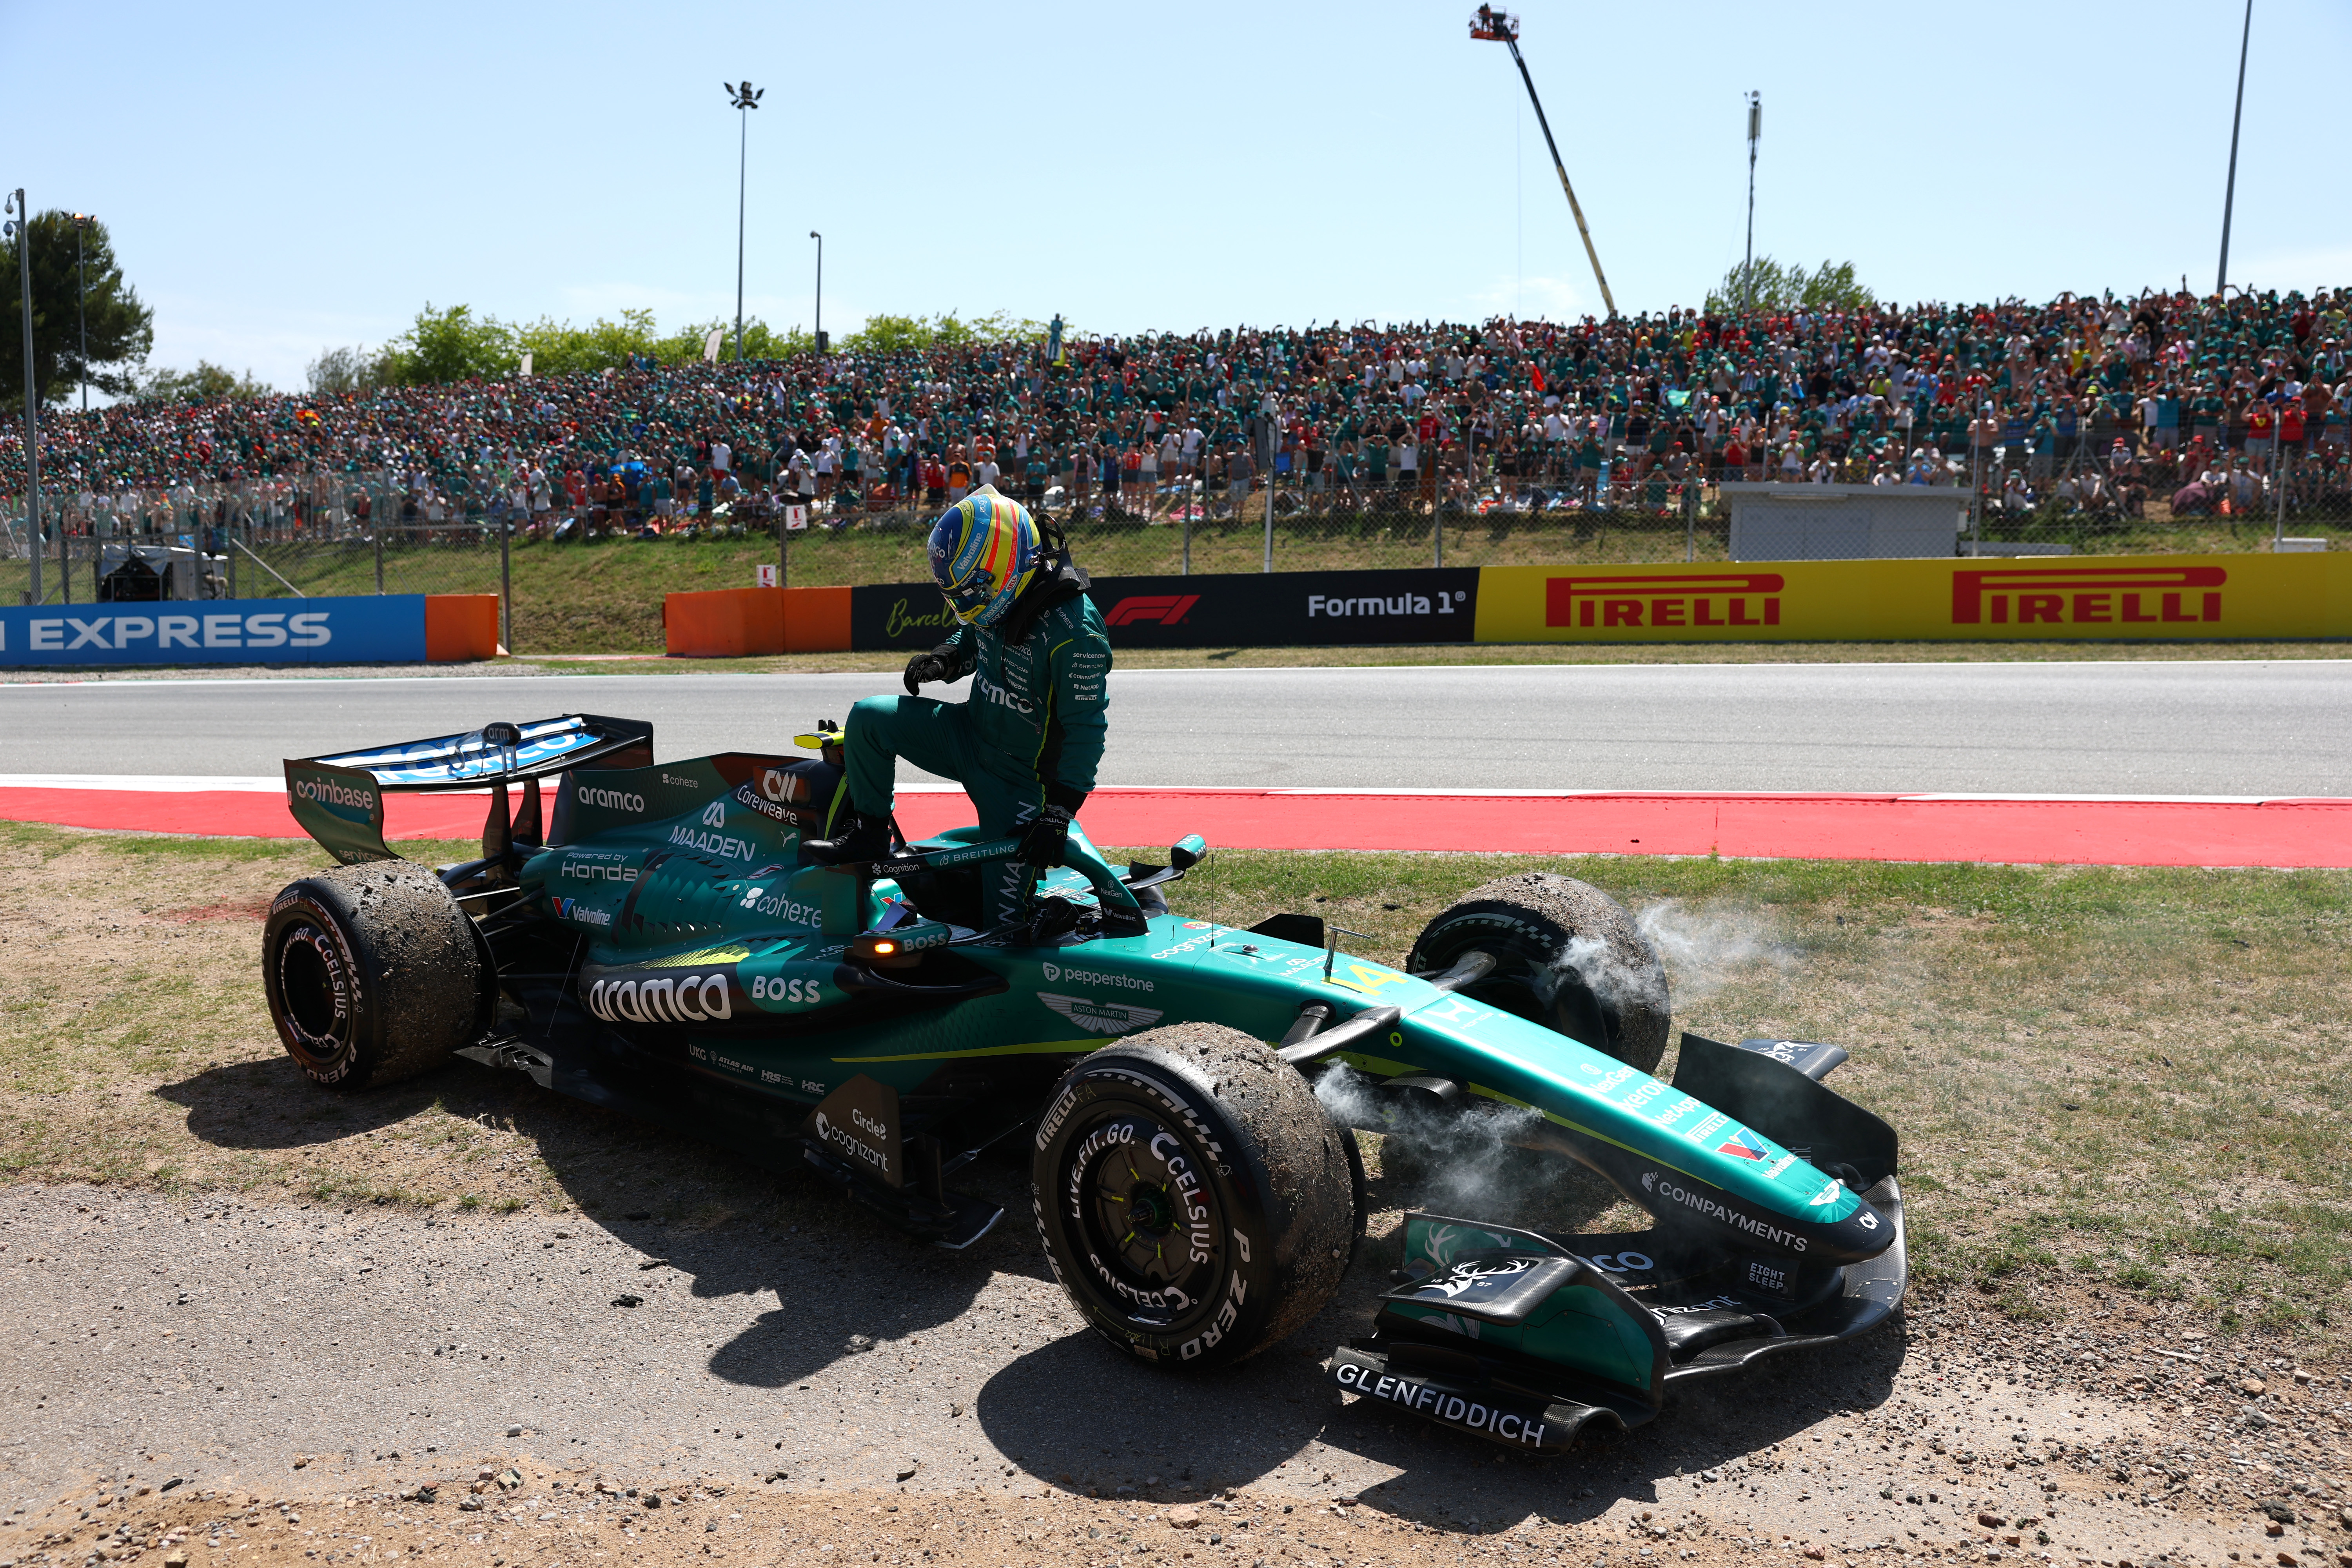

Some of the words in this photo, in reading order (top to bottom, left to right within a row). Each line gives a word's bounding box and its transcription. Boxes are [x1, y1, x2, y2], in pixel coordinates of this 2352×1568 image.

[957, 532, 983, 570] Valvoline
[960, 570, 977, 588] finetwork
[1007, 575, 1017, 590] BELL
[980, 595, 1007, 621] Flexicar
[1308, 591, 1431, 618] Formula
[1545, 573, 1785, 627] PIRELLI
[1952, 566, 2227, 624] PIRELLI
[989, 601, 1012, 622] cognizant
[30, 612, 331, 650] EXPRESS
[1002, 645, 1014, 654] FRMULA
[1005, 659, 1028, 673] Honda
[1007, 669, 1027, 683] Valvoline
[488, 724, 510, 740] arm
[296, 777, 373, 810] coinbase
[670, 776, 698, 789] cohere
[579, 786, 644, 813] aramco
[668, 825, 755, 862] MAADEN
[953, 845, 1015, 861] BREITLING
[566, 852, 612, 860] Powered
[613, 853, 628, 862] by
[883, 863, 920, 874] Cognition
[561, 861, 638, 882] Honda
[272, 889, 299, 915] PIRELLI
[1101, 887, 1122, 898] NexGen
[572, 906, 610, 926] Valvoline
[757, 893, 822, 928] cohere
[1112, 912, 1136, 921] Valvoline
[903, 933, 947, 952] BOSS
[1151, 926, 1239, 959] cognizant
[322, 949, 347, 1019] CELSIUS
[752, 975, 820, 1004] BOSS
[1065, 967, 1154, 992] pepperstone
[1321, 964, 1408, 996] 14
[589, 974, 731, 1022] aramco
[1073, 1004, 1096, 1015] ASTON
[1099, 1007, 1127, 1019] MARTIN
[1459, 1012, 1494, 1030] Honda
[689, 1044, 706, 1060] UKG
[718, 1056, 740, 1068] ATLAS
[741, 1064, 754, 1073] AIR
[307, 1060, 349, 1083] ZERO
[718, 1062, 742, 1074] WORLDWIDE
[761, 1069, 781, 1082] HRS
[1588, 1065, 1639, 1096] NexGen
[802, 1080, 825, 1093] HRC
[1617, 1079, 1671, 1113] xerox
[1036, 1084, 1077, 1152] PIRELLI
[1649, 1096, 1701, 1128] NetApp
[1685, 1111, 1730, 1143] PIRELLI
[831, 1126, 888, 1172] cognizant
[1762, 1153, 1798, 1180] Valvoline
[1167, 1156, 1210, 1265] CELSIUS
[1659, 1181, 1809, 1253] COINPAYMENTS
[1233, 1227, 1250, 1263] P
[1090, 1253, 1167, 1308] CELSIUS
[1749, 1272, 1784, 1290] SLEEP
[1750, 1262, 1785, 1281] EIGHT
[1180, 1269, 1247, 1361] ZERO
[1336, 1363, 1546, 1448] GLENFIDDICH
